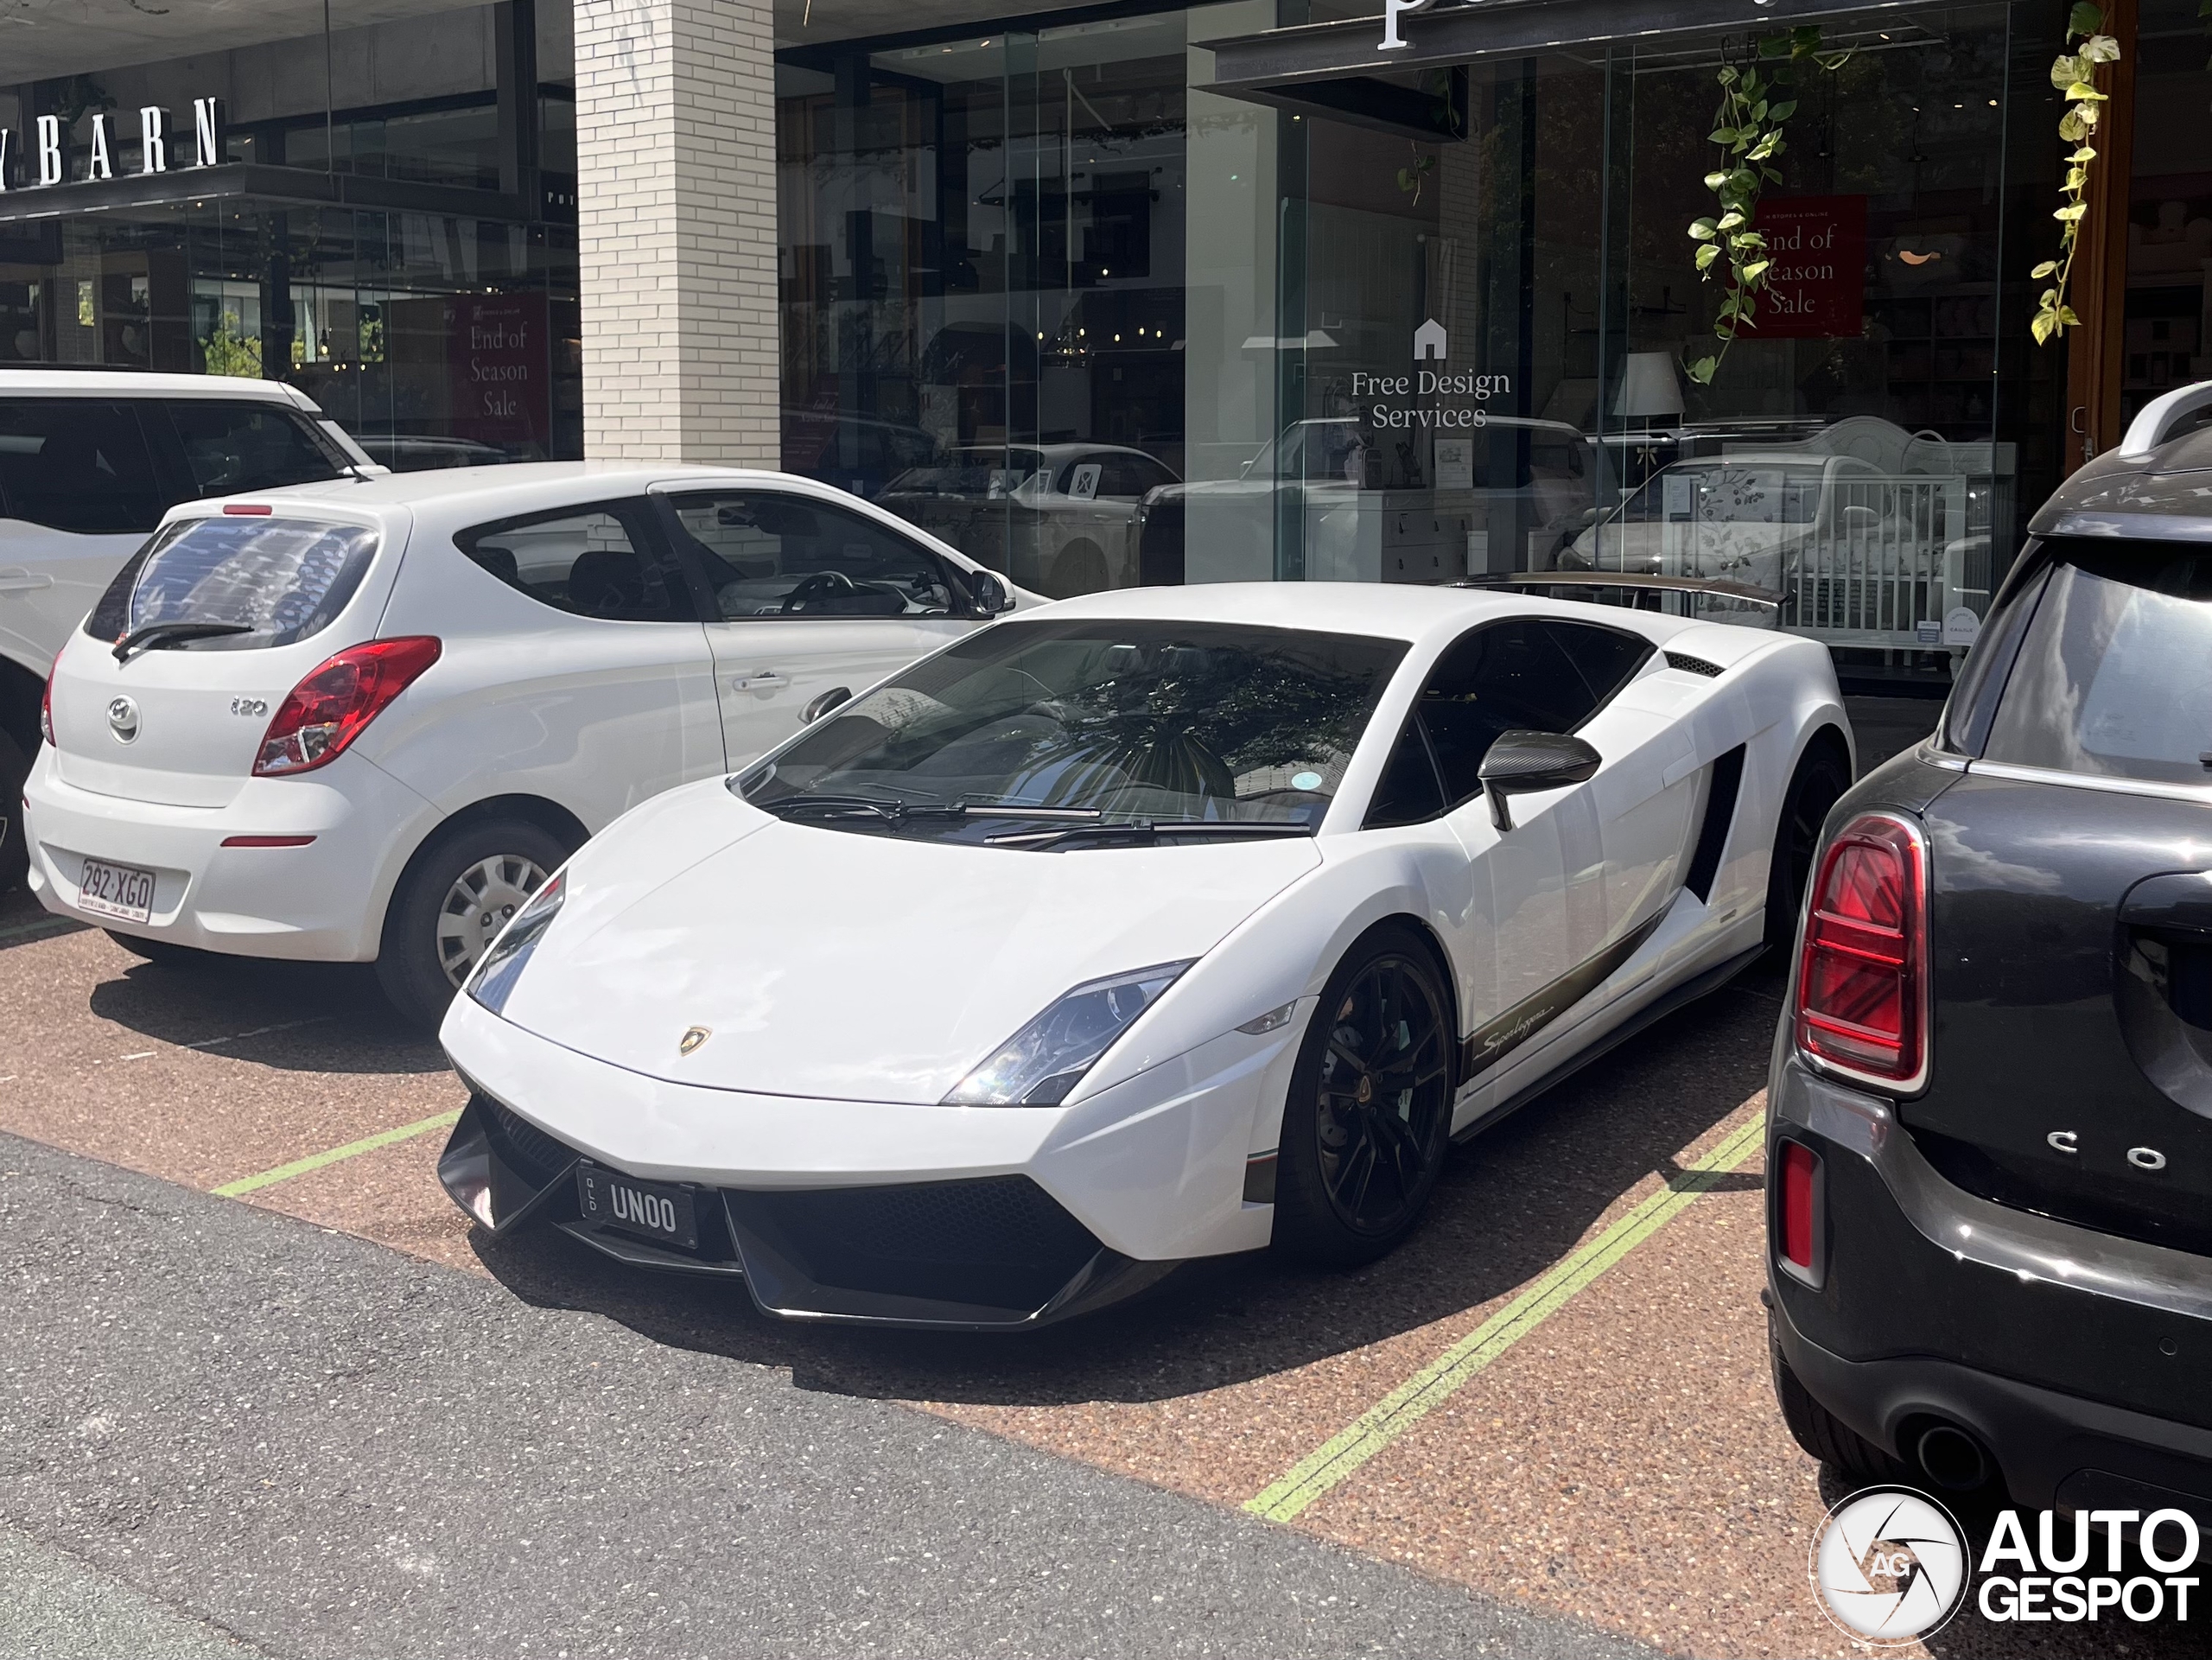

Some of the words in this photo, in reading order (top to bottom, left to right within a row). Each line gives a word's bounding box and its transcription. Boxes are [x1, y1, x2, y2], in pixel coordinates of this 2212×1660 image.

[37, 97, 216, 187] BARN
[1809, 223, 1838, 250] of
[1766, 264, 1834, 282] eason
[1769, 289, 1815, 315] Sale
[471, 322, 503, 350] End
[509, 321, 528, 349] of
[471, 357, 528, 382] Season
[1351, 372, 1409, 396] Free
[1417, 368, 1510, 400] Design
[483, 390, 517, 417] Sale
[1372, 402, 1486, 428] Services
